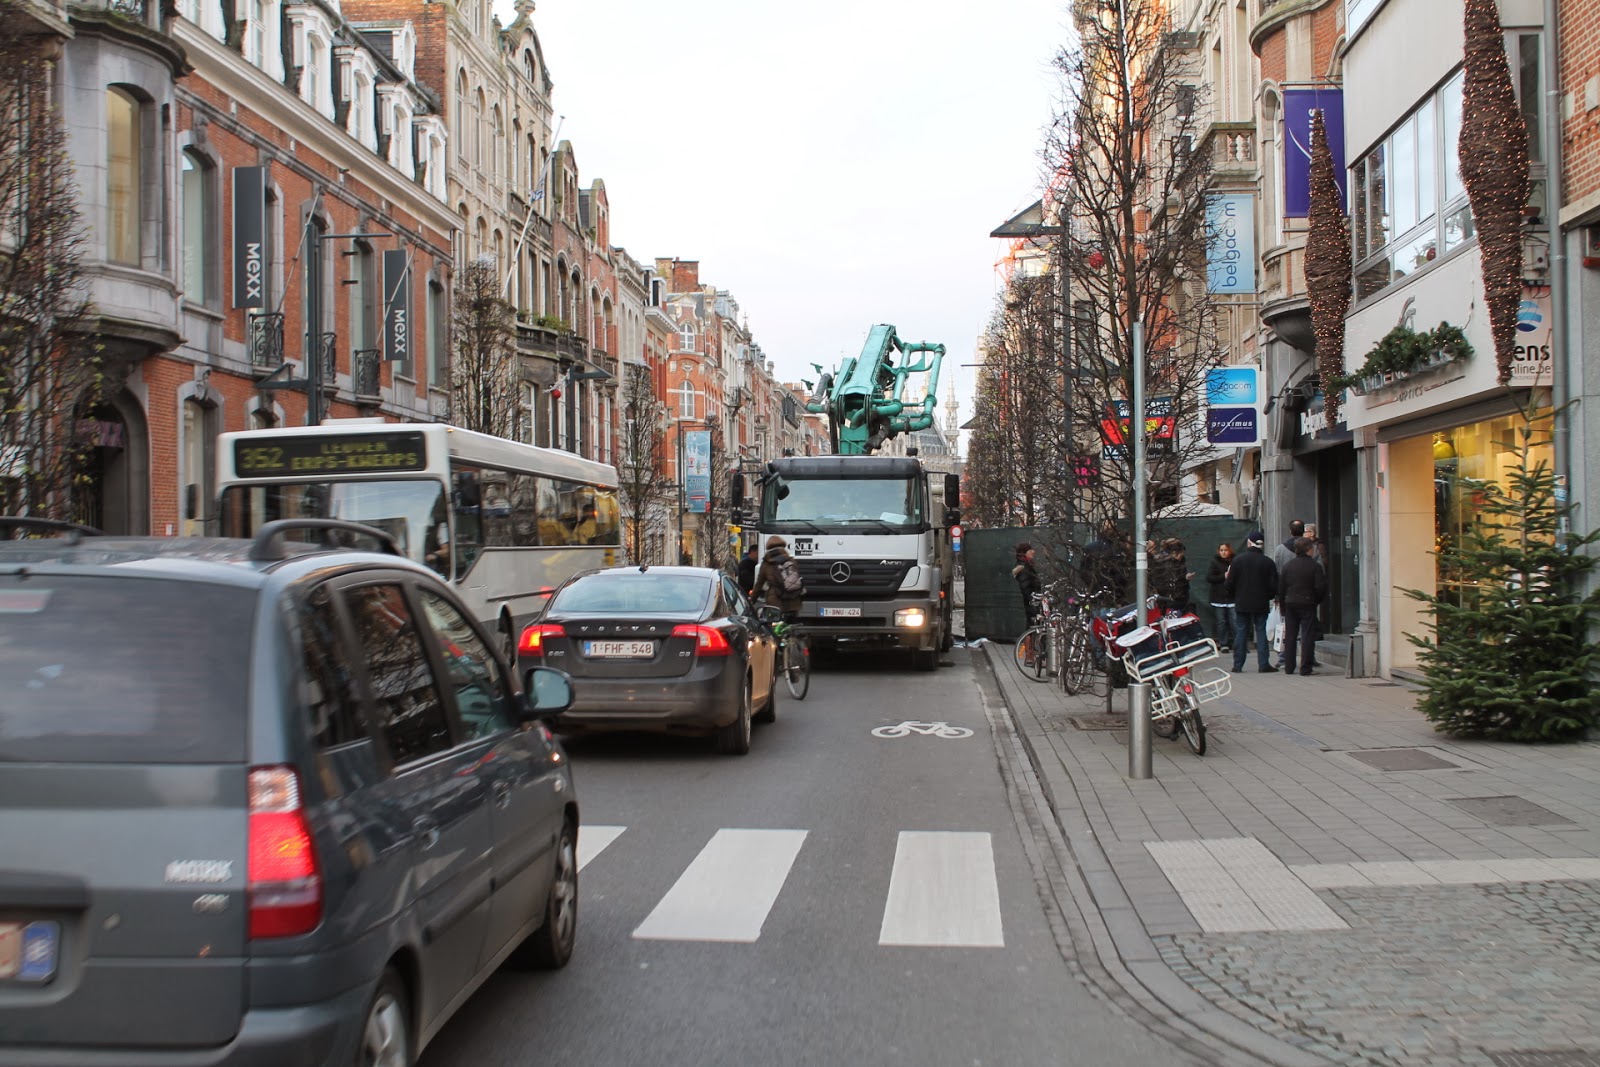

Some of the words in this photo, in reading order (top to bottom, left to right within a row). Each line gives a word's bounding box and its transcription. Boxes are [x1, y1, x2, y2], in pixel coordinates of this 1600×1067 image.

[1221, 202, 1241, 287] belgacom
[1399, 384, 1423, 403] OPTICS
[240, 446, 284, 469] 352
